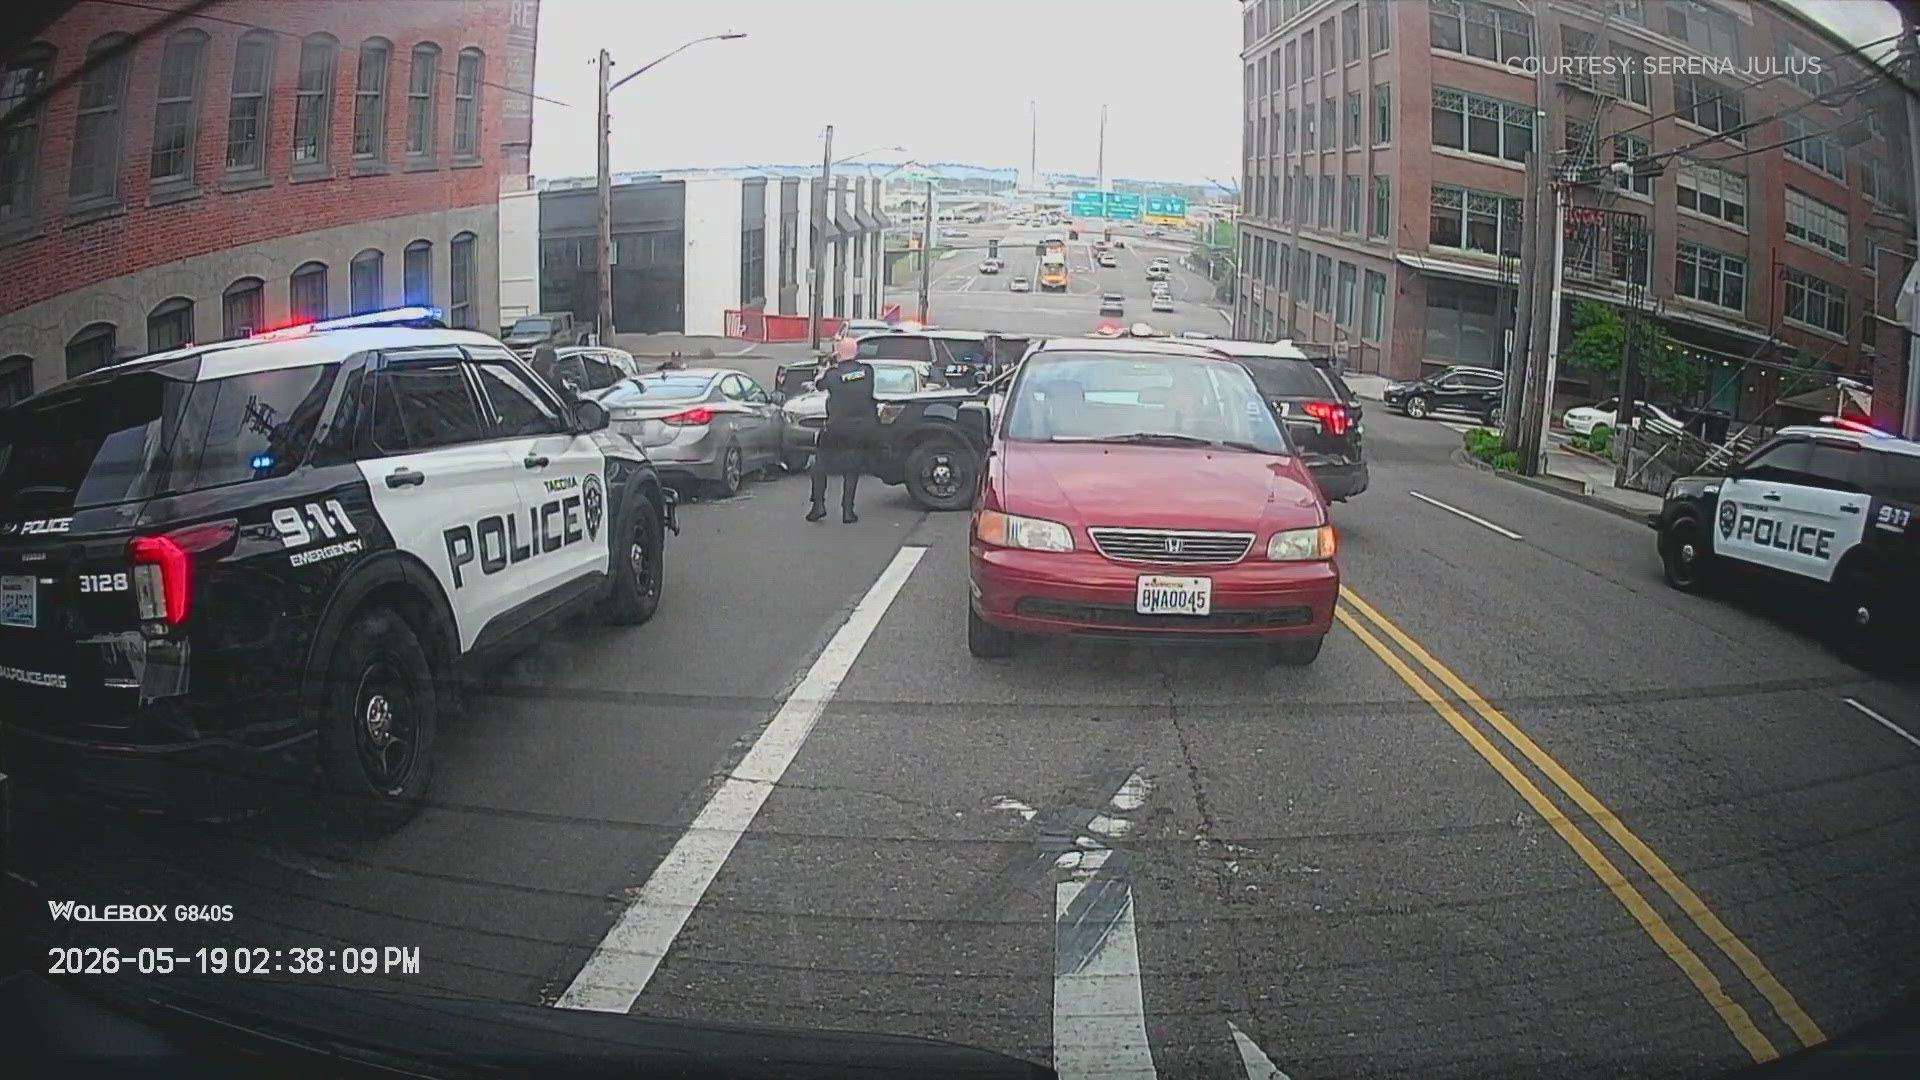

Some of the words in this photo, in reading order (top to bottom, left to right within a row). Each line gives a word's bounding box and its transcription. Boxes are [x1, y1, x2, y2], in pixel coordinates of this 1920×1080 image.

[21, 517, 73, 535] POLICE
[1737, 514, 1835, 560] POLICE
[289, 538, 363, 568] EMERGENCY
[443, 495, 583, 590] POLICE
[79, 573, 129, 592] 3128
